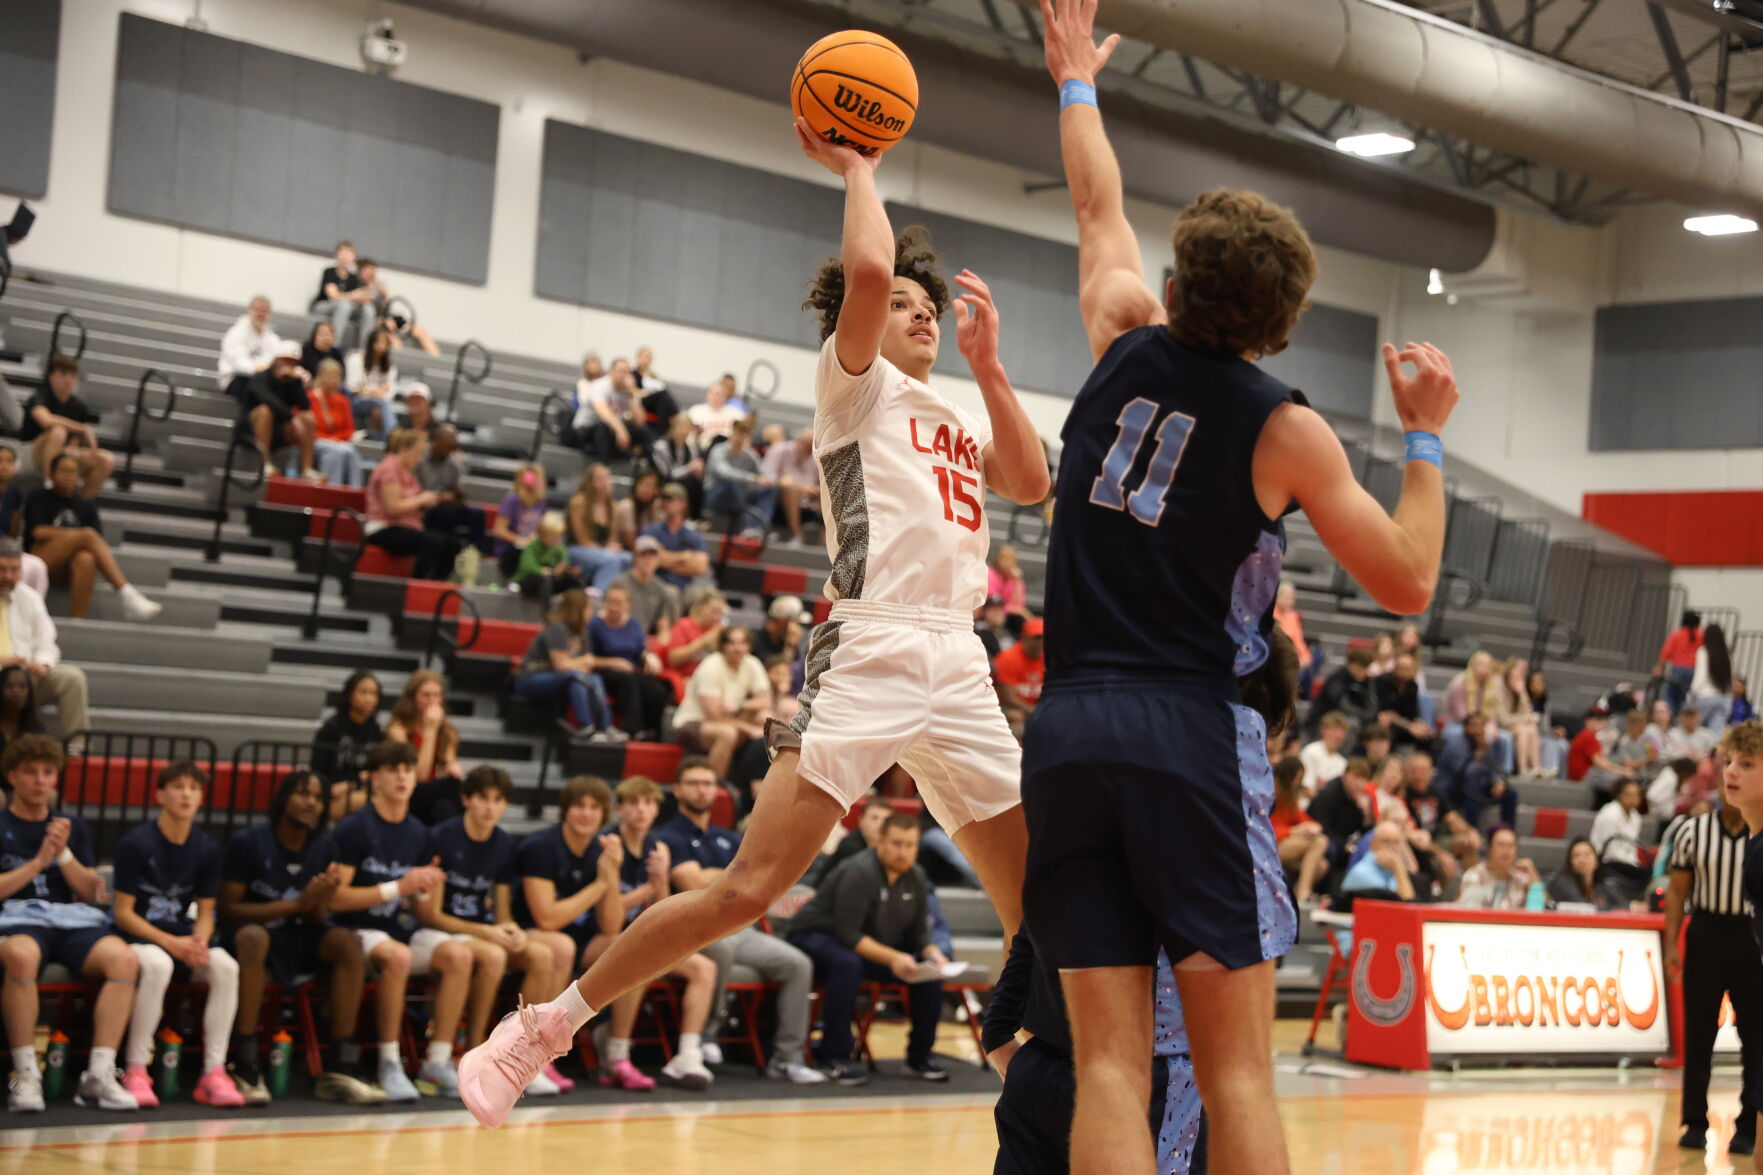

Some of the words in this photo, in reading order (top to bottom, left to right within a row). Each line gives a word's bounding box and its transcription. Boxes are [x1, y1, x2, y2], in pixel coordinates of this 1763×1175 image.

[833, 83, 906, 133] Wilson
[1089, 396, 1196, 527] 11
[931, 465, 983, 533] 15
[1469, 973, 1622, 1028] BRONCOS
